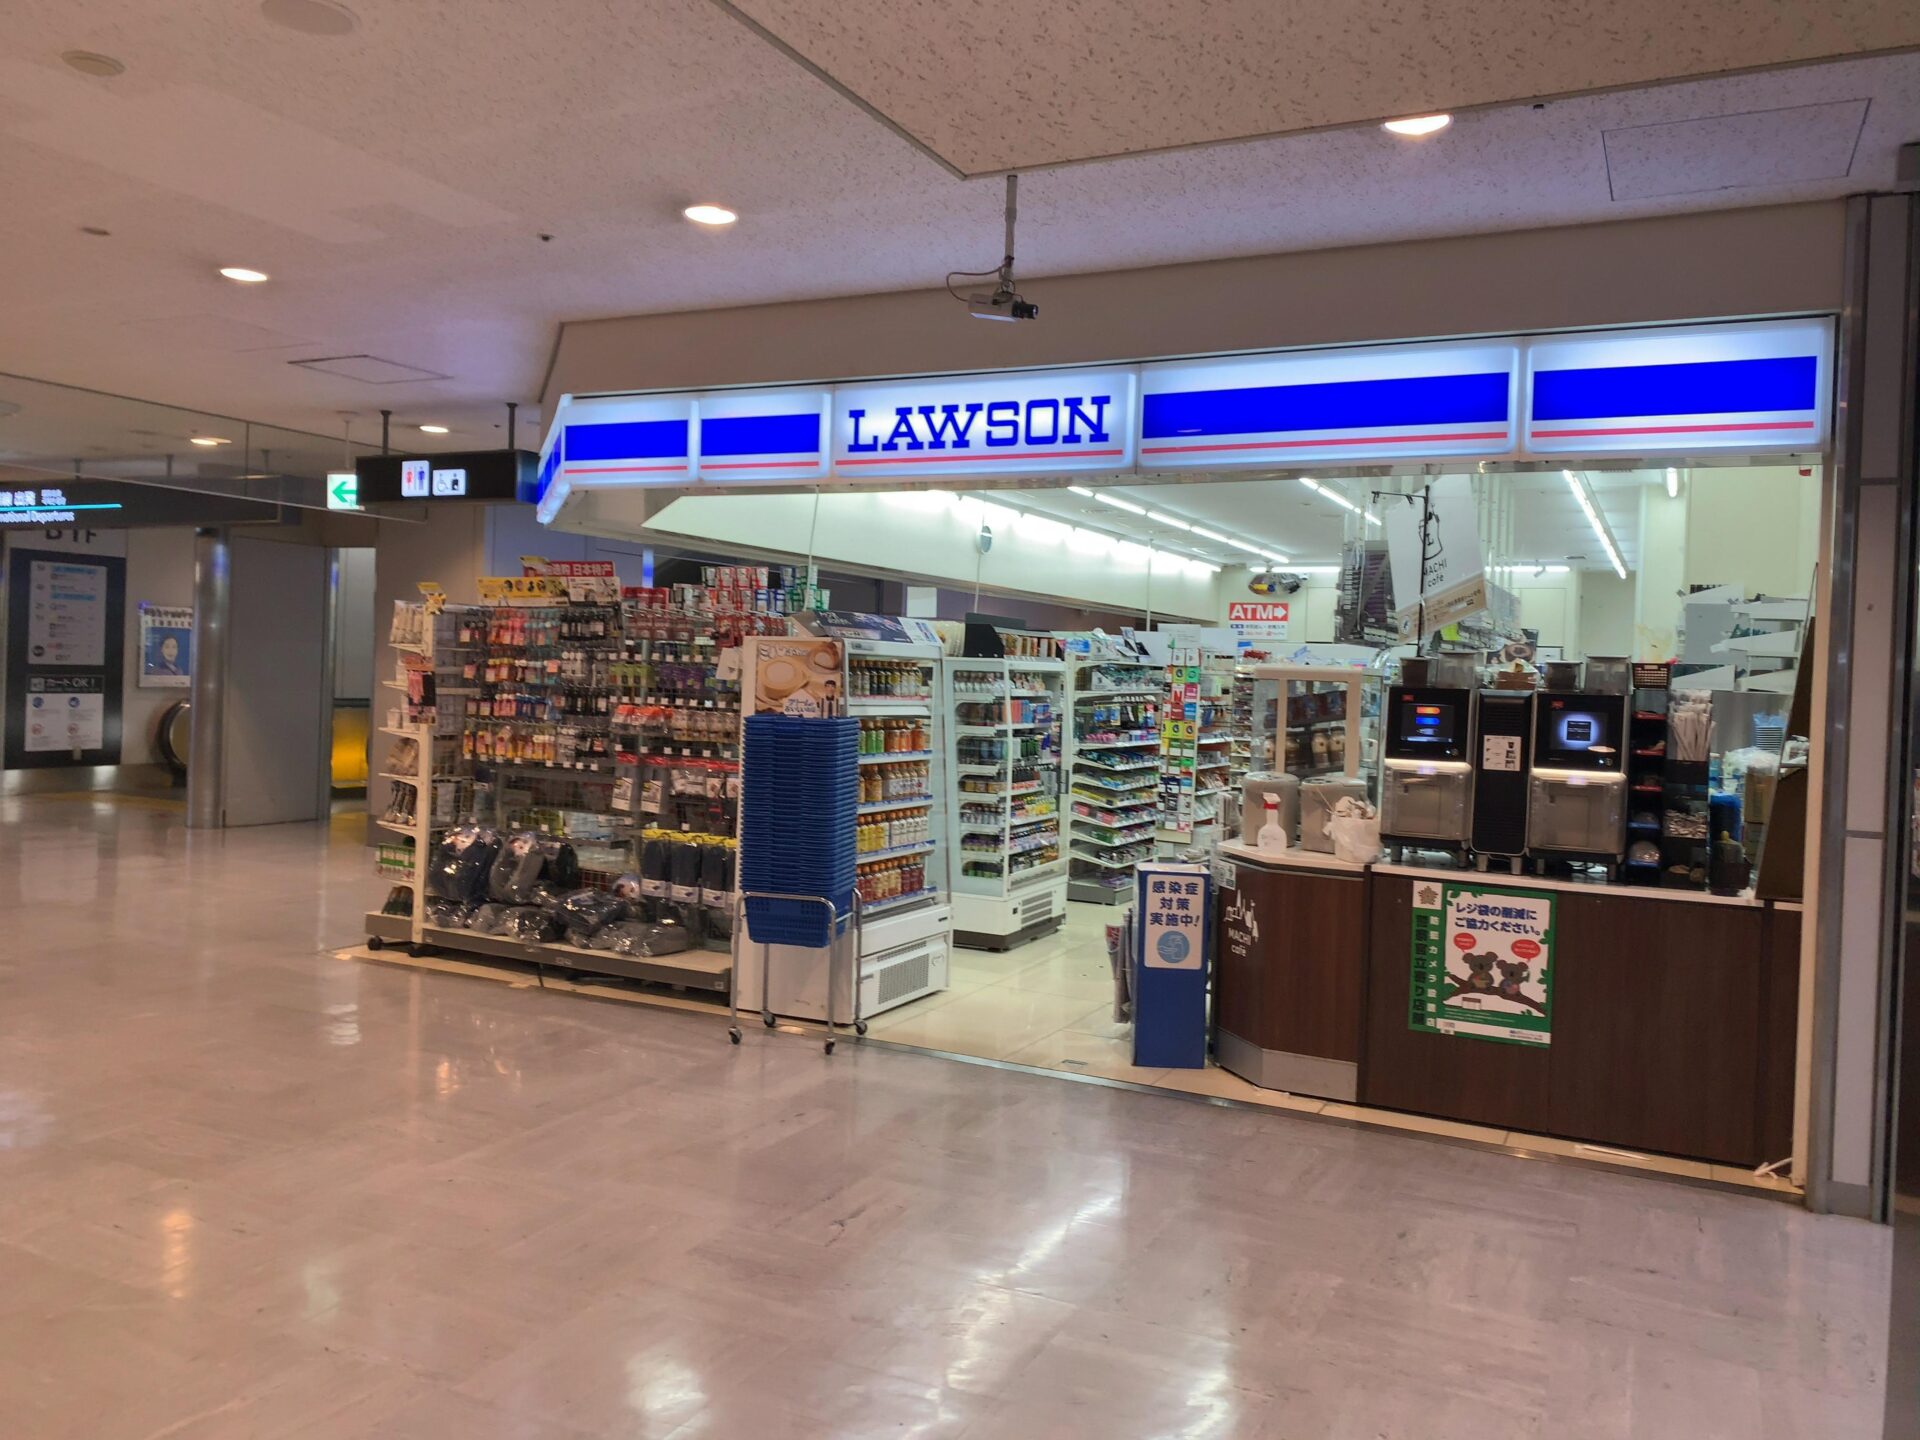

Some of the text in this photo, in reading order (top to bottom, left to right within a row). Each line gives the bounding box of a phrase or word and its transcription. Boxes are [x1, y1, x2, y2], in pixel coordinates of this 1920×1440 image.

[848, 396, 1111, 453] LAWSON
[1231, 604, 1273, 620] ATM
[1152, 881, 1199, 895] 感染症
[1160, 897, 1190, 911] 対策
[1456, 903, 1537, 920] レジ袋の削減に
[1150, 912, 1200, 927] 実施中!
[1455, 917, 1541, 936] ご協力ください。
[1228, 927, 1251, 945] MACHI
